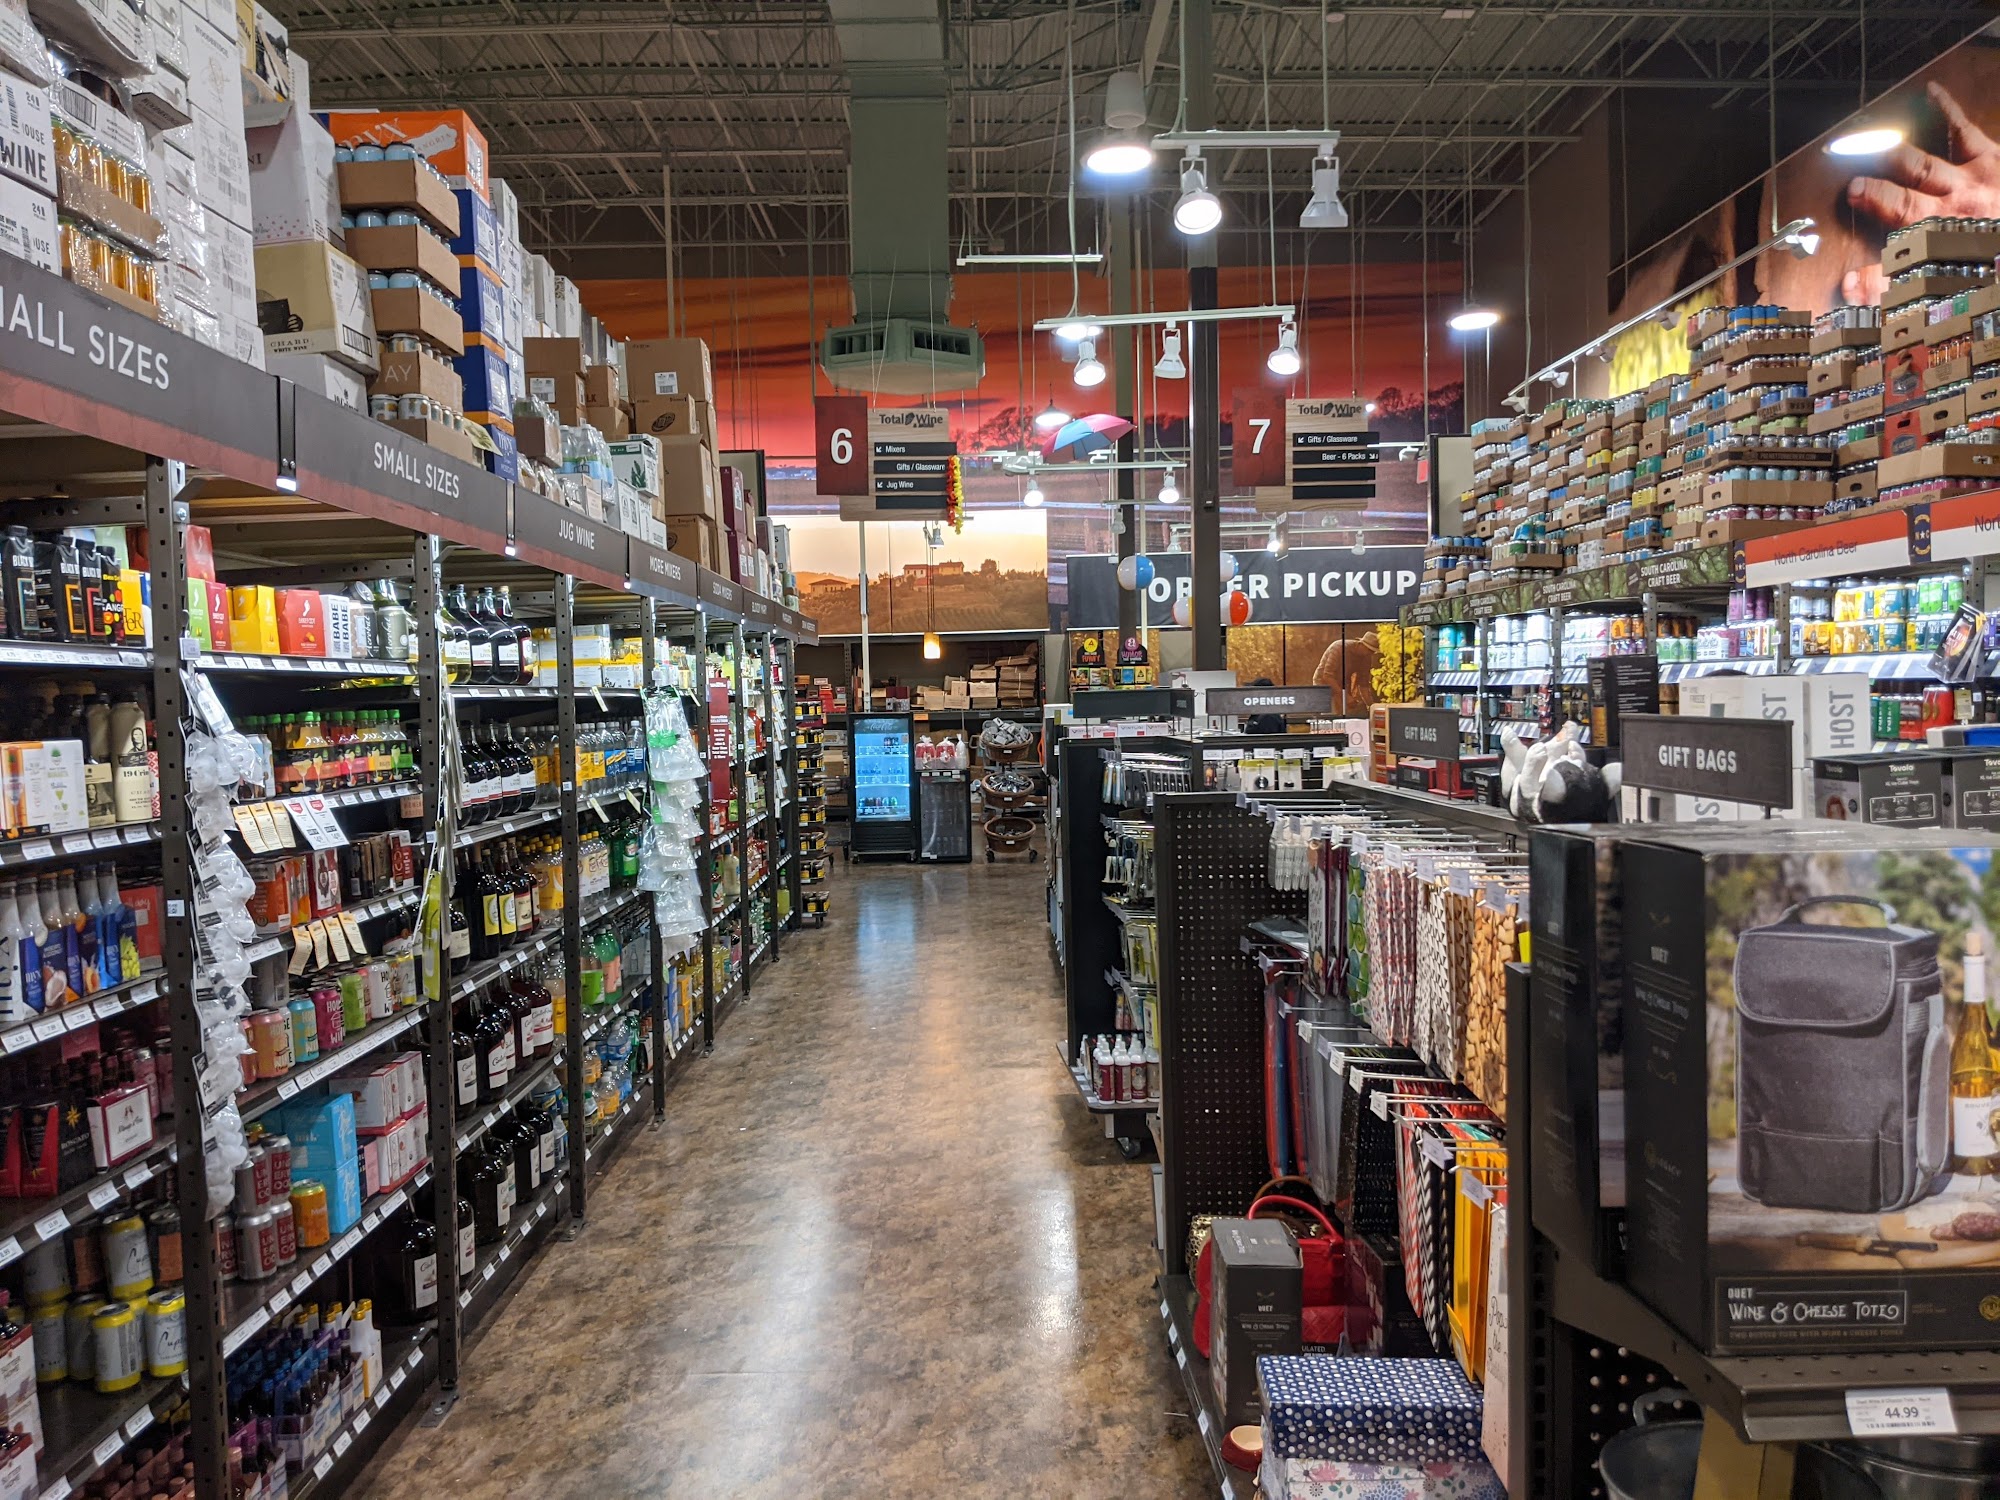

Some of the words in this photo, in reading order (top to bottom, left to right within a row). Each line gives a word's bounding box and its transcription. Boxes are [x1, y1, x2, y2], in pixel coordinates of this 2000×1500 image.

[417, 132, 452, 154] ANGRIA
[0, 137, 48, 183] WINE
[88, 325, 169, 390] SIZES
[376, 364, 412, 383] AY
[1297, 403, 1323, 415] Total
[1334, 404, 1362, 415] Wine
[879, 413, 905, 424] Total
[915, 413, 943, 425] Wine
[1248, 418, 1271, 454] 7
[1326, 435, 1358, 443] Glassware
[830, 428, 853, 465] 6
[1321, 453, 1336, 461] Beer
[374, 441, 421, 485] SMALL
[425, 463, 460, 499] SIZES
[896, 463, 910, 471] Gifts
[886, 481, 897, 490] Jug
[898, 481, 914, 489] Wine
[558, 518, 573, 541] JUG
[575, 525, 595, 550] WINE
[1774, 551, 1797, 566] North
[1799, 545, 1835, 561] Carolina
[1836, 540, 1858, 553] Beer
[649, 555, 664, 573] MORE
[664, 560, 681, 581] MIXERS
[1640, 564, 1659, 577] SOUTH
[1659, 559, 1688, 574] CAROLINA
[1149, 574, 1270, 603] ORER
[1283, 570, 1417, 599] PICKUP
[1542, 585, 1556, 595] SOUTH
[1556, 581, 1577, 592] CAROLINA
[1648, 576, 1666, 588] CRAFT
[1666, 573, 1681, 584] BEER
[1469, 598, 1480, 608] SOUTH
[1480, 596, 1497, 605] CAROLINA
[1547, 595, 1560, 604] CRAFT
[1560, 594, 1572, 602] BEER
[332, 603, 341, 641] BABE
[341, 604, 349, 642] BABE
[1243, 696, 1296, 706] OPENERS
[1761, 692, 1787, 721] ST
[1829, 690, 1855, 749] HOST
[1404, 726, 1419, 740] GIFT
[1419, 727, 1437, 742] BAGS
[1658, 745, 1690, 769] GIFT
[1696, 748, 1737, 774] BAGS
[123, 770, 133, 778] 19
[274, 1160, 290, 1169] UN
[274, 1170, 290, 1179] ER
[1727, 1287, 1753, 1299] DUET
[1728, 1302, 1766, 1322] WINE
[1770, 1302, 1788, 1324] &
[1793, 1302, 1847, 1321] CHEESE
[1884, 1406, 1919, 1419] 44.99
